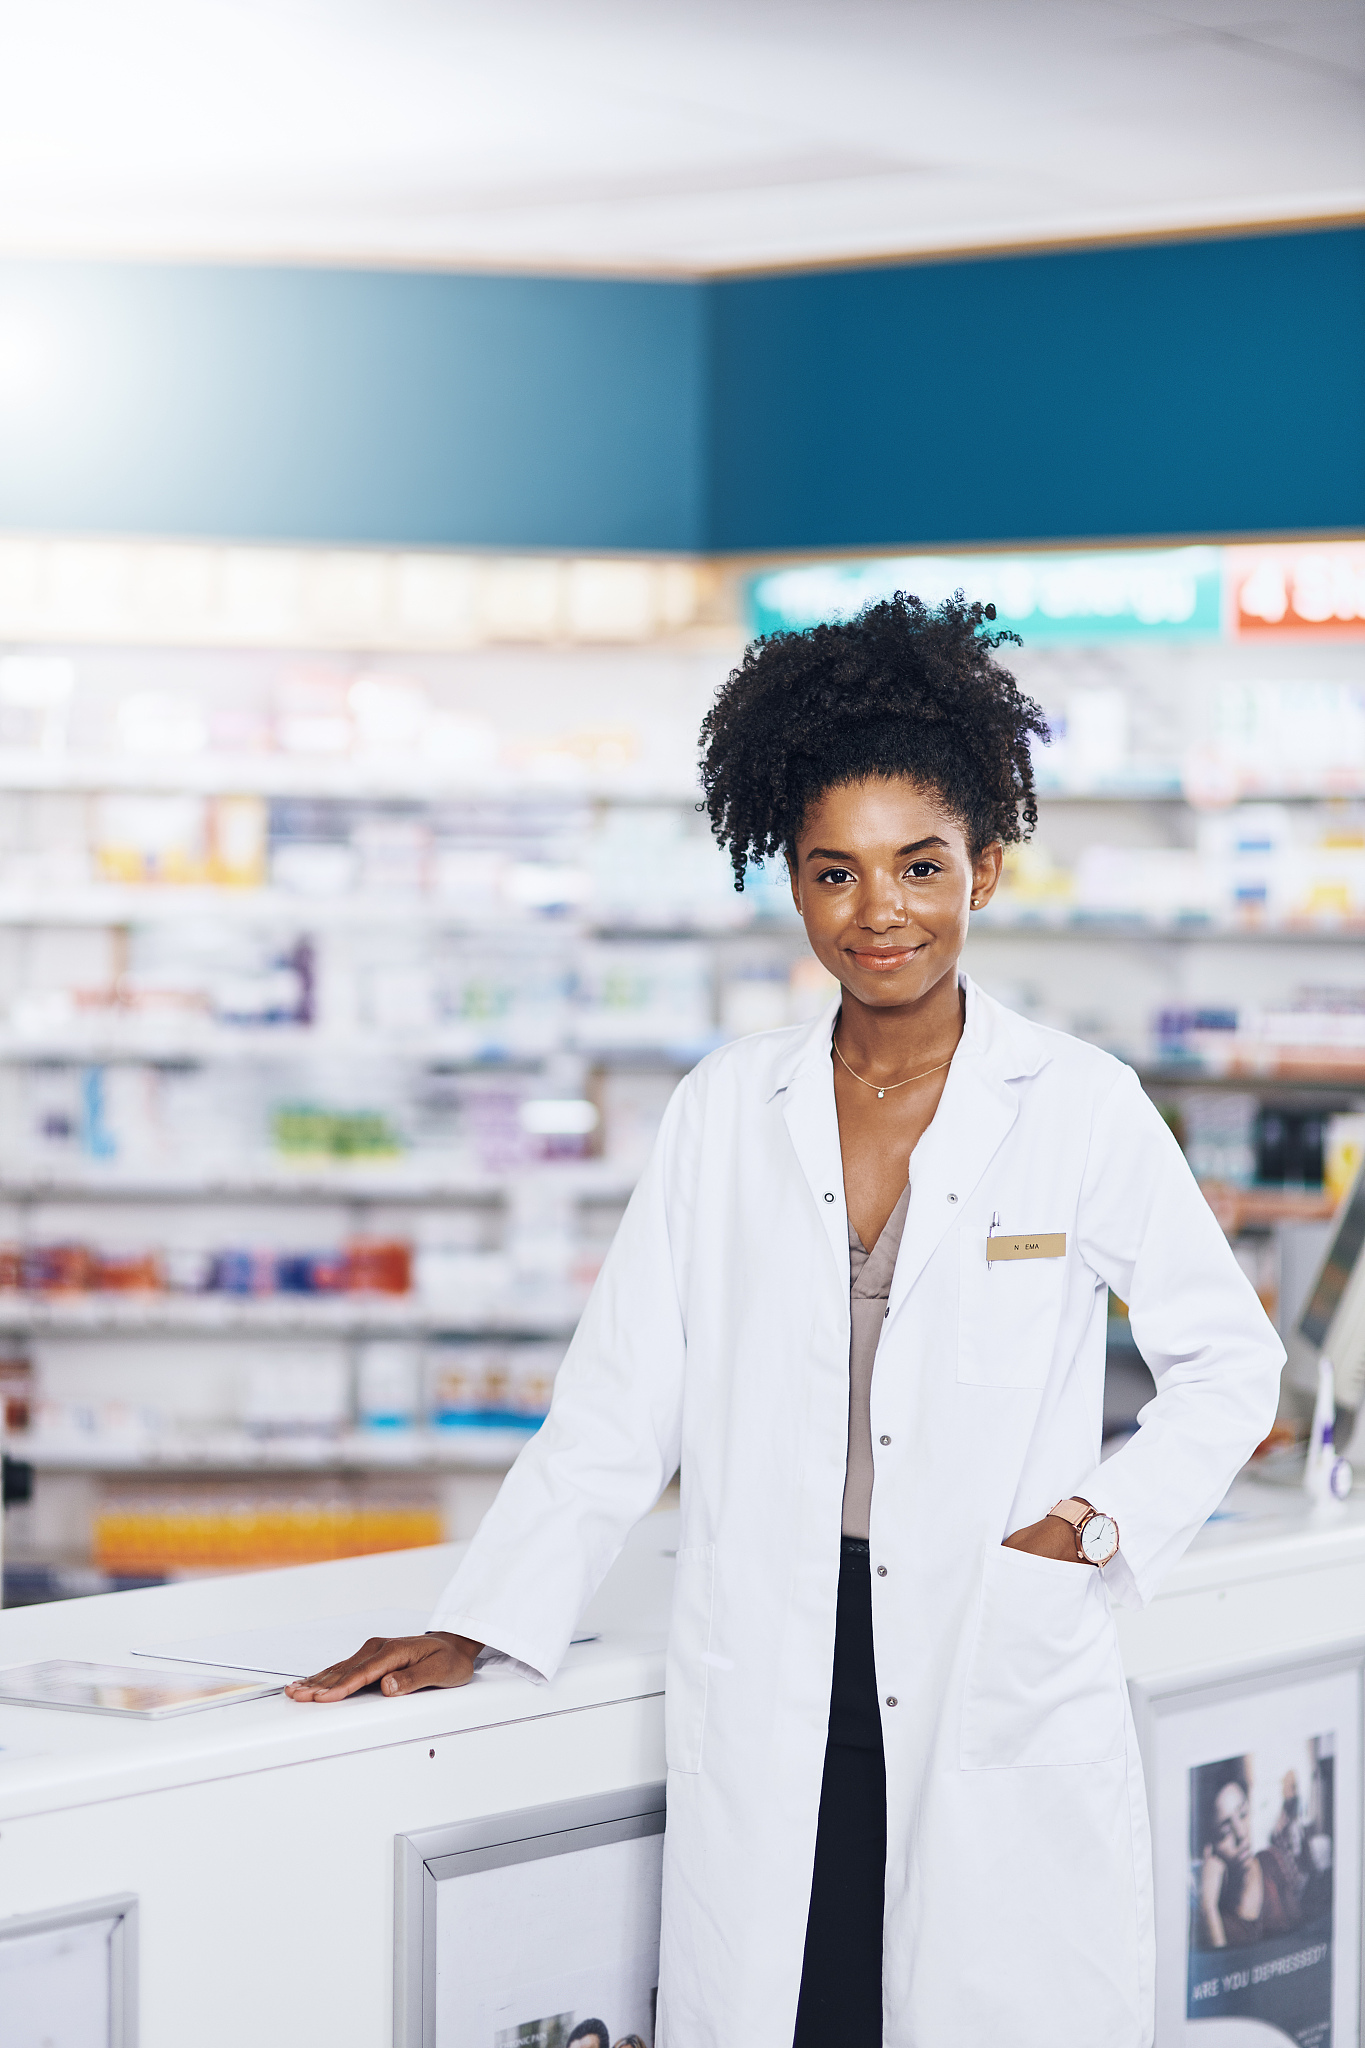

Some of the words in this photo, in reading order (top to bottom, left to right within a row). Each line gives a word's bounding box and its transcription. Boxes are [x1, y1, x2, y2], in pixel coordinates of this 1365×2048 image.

[1192, 1978, 1219, 2001] ARE
[1221, 1969, 1250, 1992] YOU
[1251, 1943, 1327, 1984] DEPRESSED?
